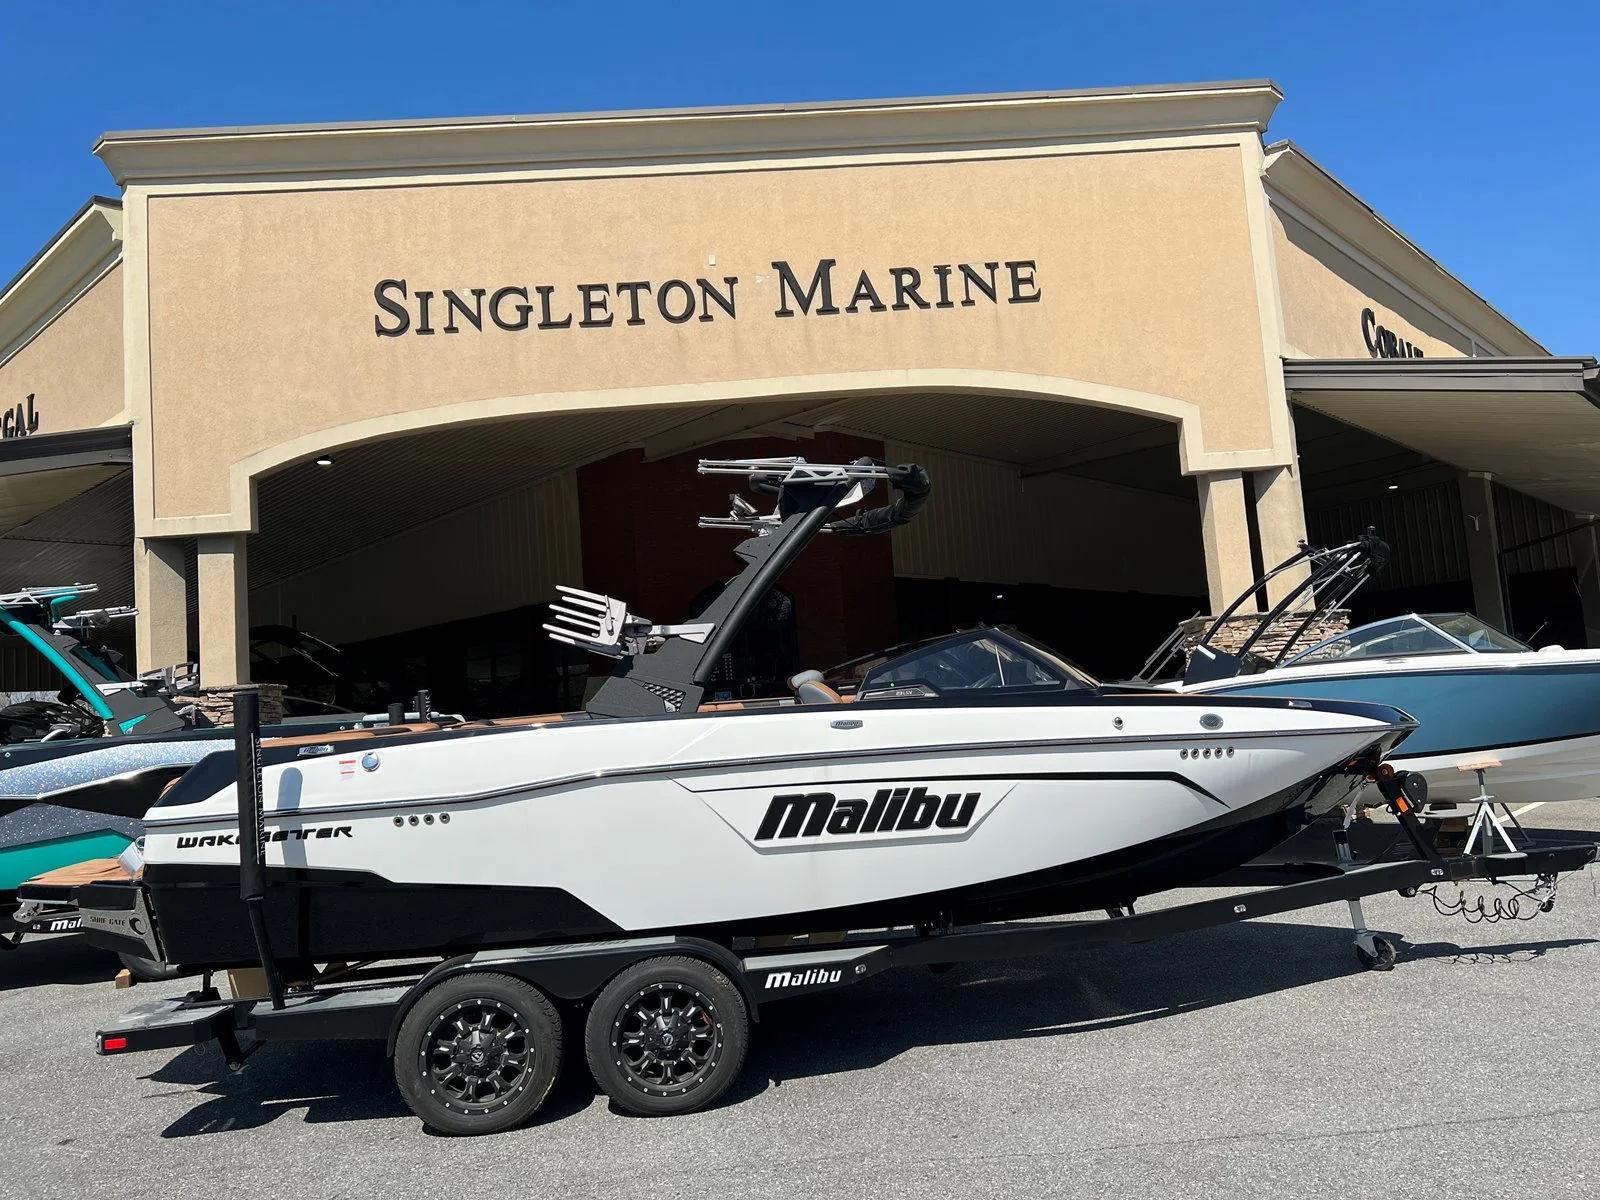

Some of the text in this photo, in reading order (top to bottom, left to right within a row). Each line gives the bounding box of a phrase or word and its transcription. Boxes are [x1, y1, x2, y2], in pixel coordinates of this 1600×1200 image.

[374, 259, 1042, 338] SINGLETON MARINE
[0, 393, 39, 438] GAL
[754, 786, 982, 841] Malibu
[176, 826, 353, 849] WAKETTER
[50, 918, 84, 932] Mal
[764, 968, 842, 989] Malibu
